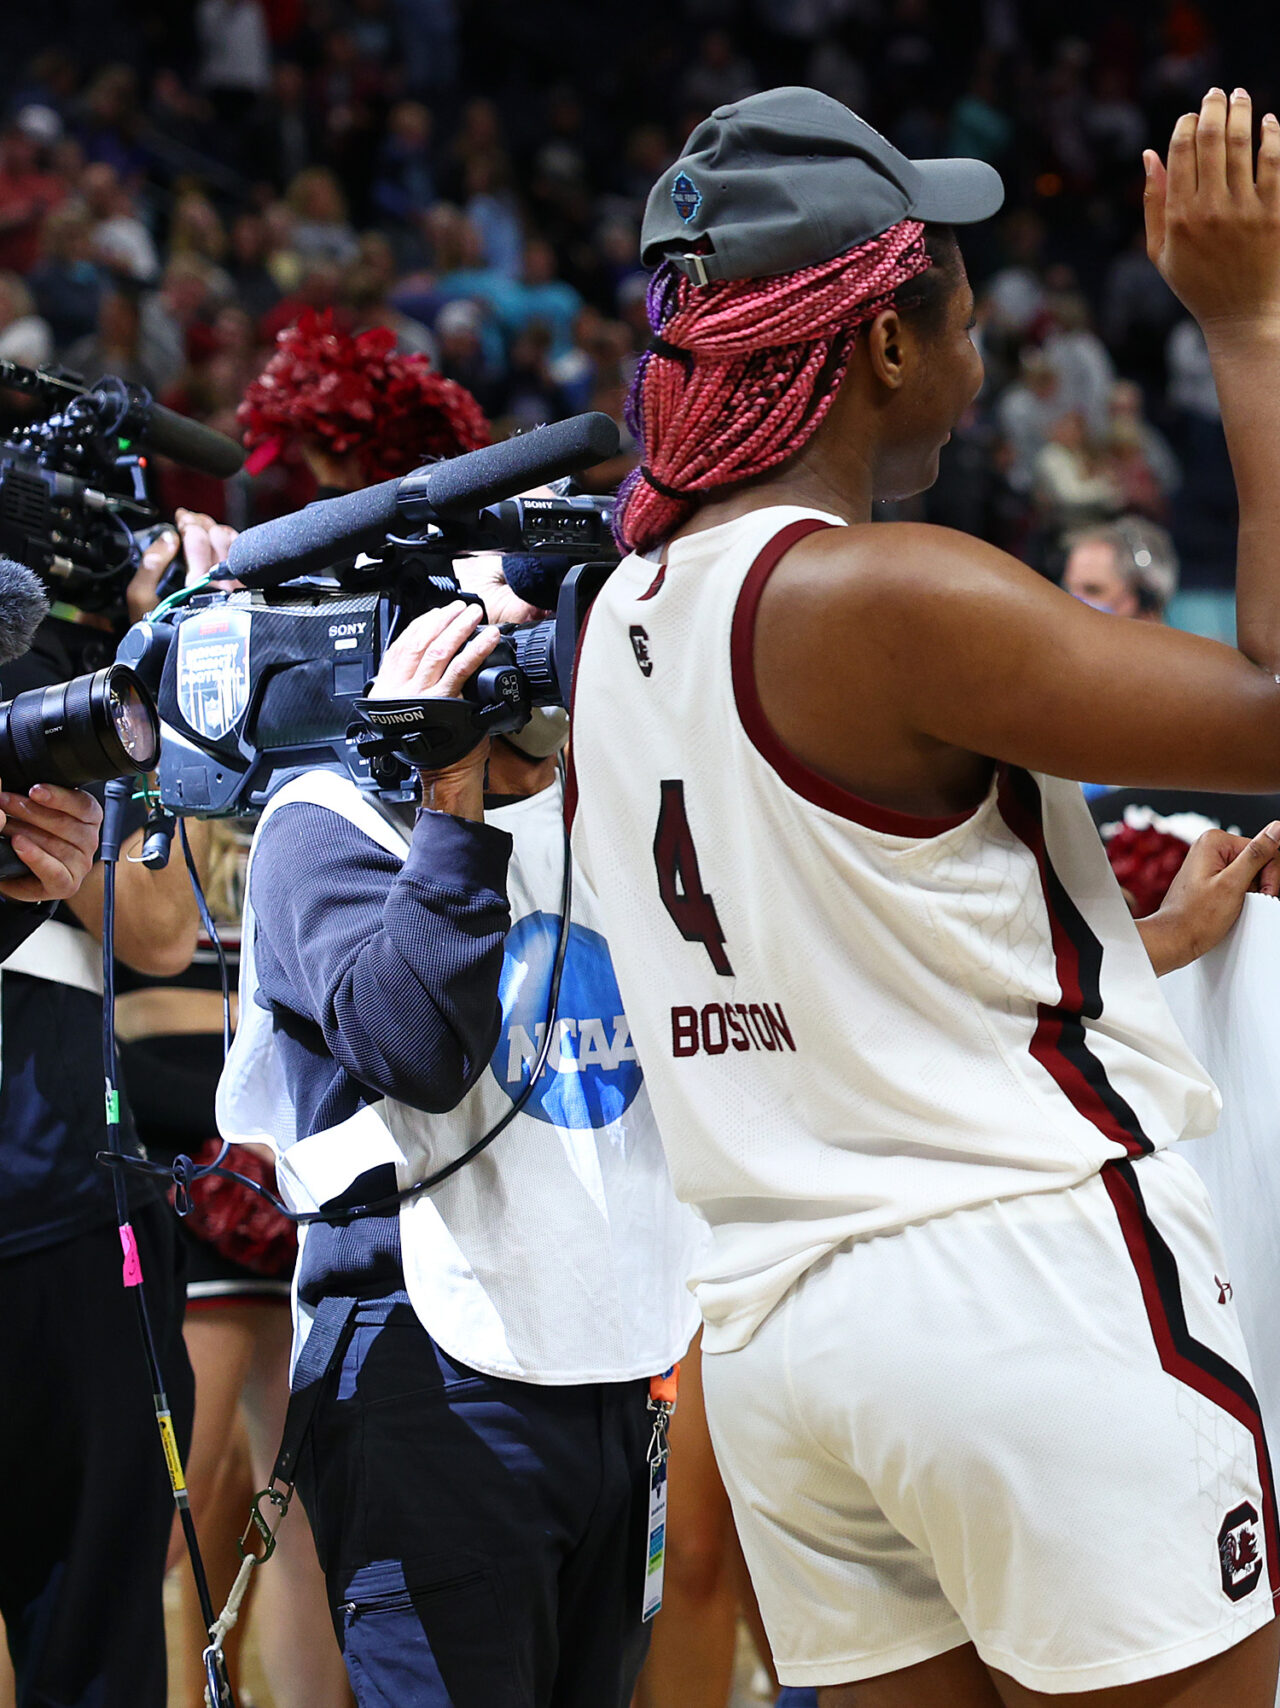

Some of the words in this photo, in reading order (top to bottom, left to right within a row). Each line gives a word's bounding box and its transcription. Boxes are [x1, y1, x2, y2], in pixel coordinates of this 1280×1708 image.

[523, 500, 553, 509] SONY
[328, 622, 367, 637] SONY
[370, 710, 425, 725] FUJINON
[44, 725, 63, 735] SONY
[653, 779, 735, 977] 4
[671, 1002, 796, 1057] BOSTON
[506, 1014, 642, 1083] NCAA
